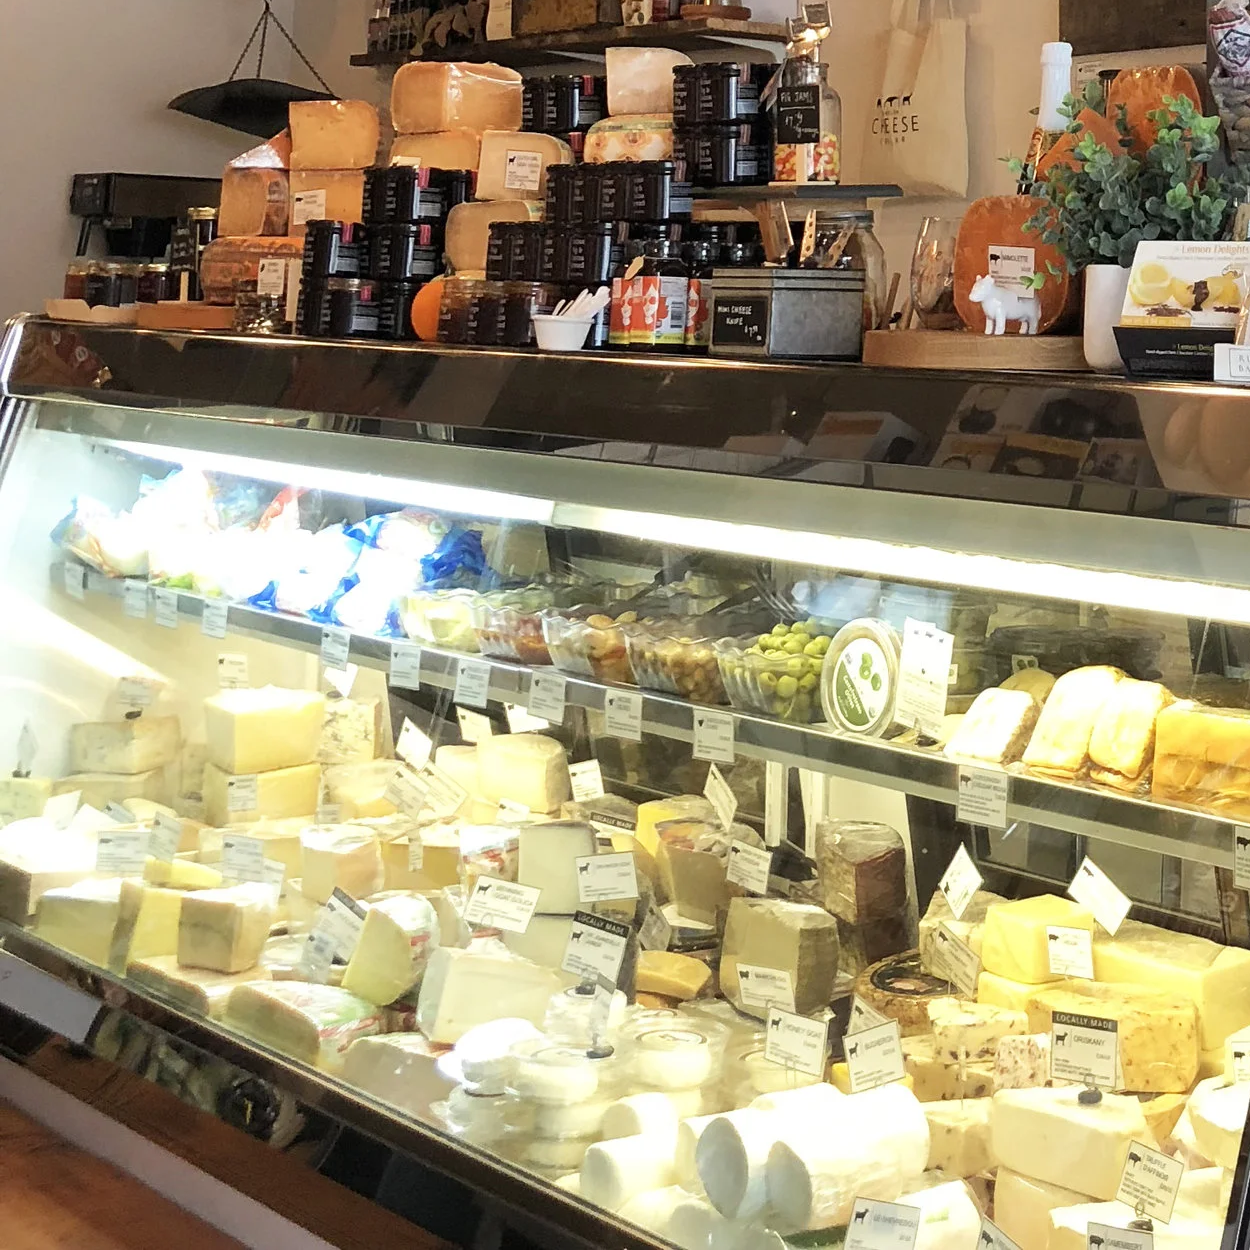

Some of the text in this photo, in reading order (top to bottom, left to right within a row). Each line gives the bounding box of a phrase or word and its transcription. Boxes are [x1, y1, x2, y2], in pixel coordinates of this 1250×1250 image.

[871, 115, 920, 135] CHEESE
[1181, 244, 1250, 256] Lemon Delights
[577, 913, 625, 936] LOCALLY MADE
[1056, 1013, 1112, 1030] LOCALLY MADE
